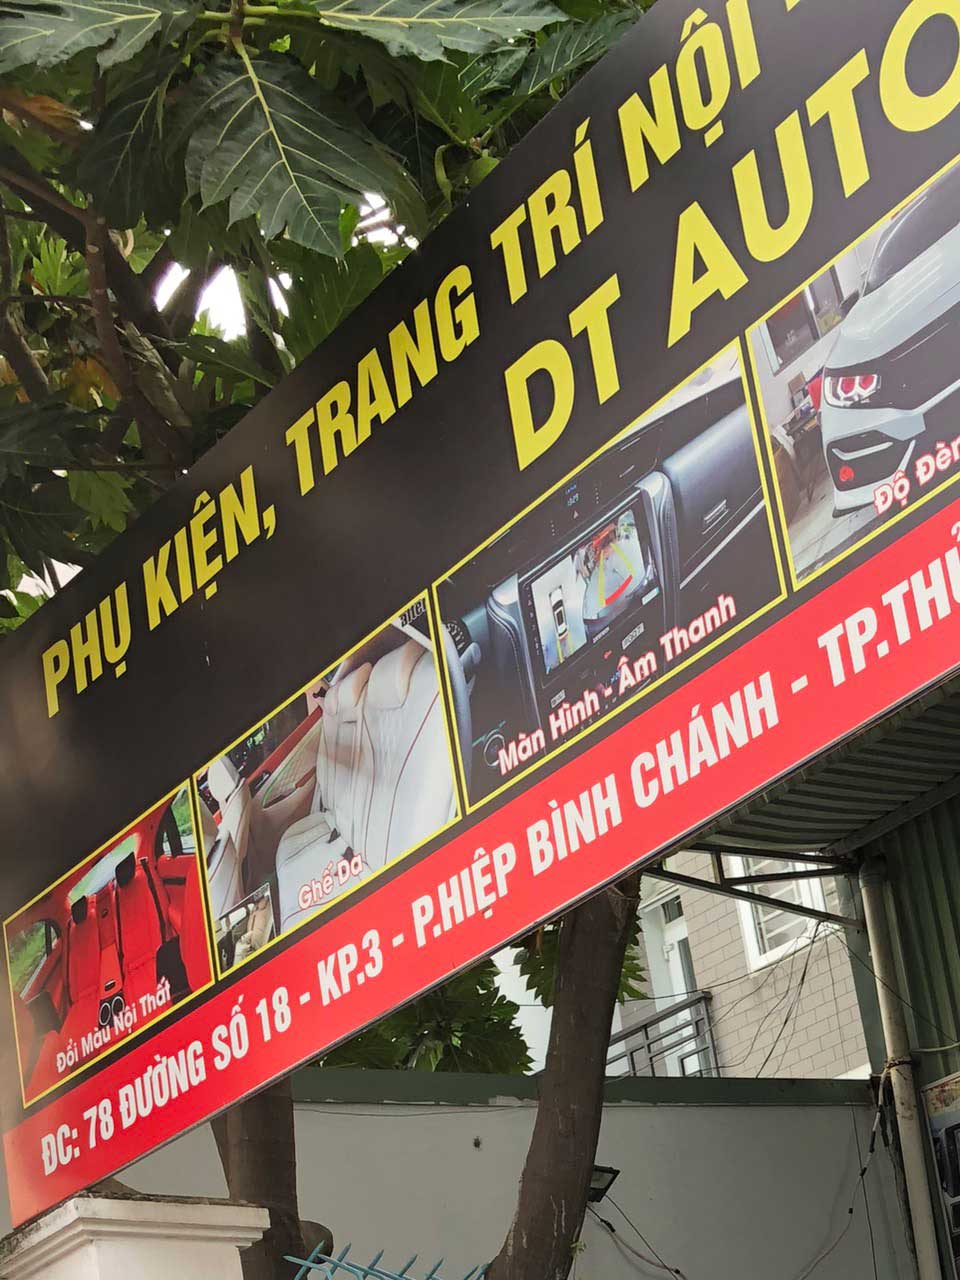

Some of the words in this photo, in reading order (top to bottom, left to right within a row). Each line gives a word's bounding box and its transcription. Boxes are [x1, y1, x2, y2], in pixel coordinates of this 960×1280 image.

[41, 581, 132, 718] PHỤ
[142, 465, 277, 630] KIỆN,
[285, 264, 480, 496] TRANG
[490, 116, 604, 305] TRÍ
[617, 0, 762, 193] NỘI
[504, 273, 621, 471] DT
[498, 728, 546, 776] Màn
[549, 690, 601, 741] Hình
[617, 649, 657, 697] Âm
[660, 592, 737, 662] Thanh
[41, 1124, 81, 1176] ĐC:
[82, 1097, 114, 1151] 78
[117, 1041, 206, 1132] ĐƯỜNG
[211, 995, 250, 1071] SỐ
[255, 986, 291, 1042] 18
[316, 929, 384, 1007] KP.3
[411, 842, 517, 949] P.HIỆP
[526, 774, 623, 878] BÌNH
[630, 671, 780, 809] CHÁNH
[790, 674, 809, 695] -
[298, 860, 336, 911] Ghế
[337, 852, 364, 886] Da
[56, 1037, 79, 1073] Đổi
[80, 1025, 112, 1056] Màu
[112, 1005, 137, 1037] Nội
[139, 976, 173, 1018] Thất
